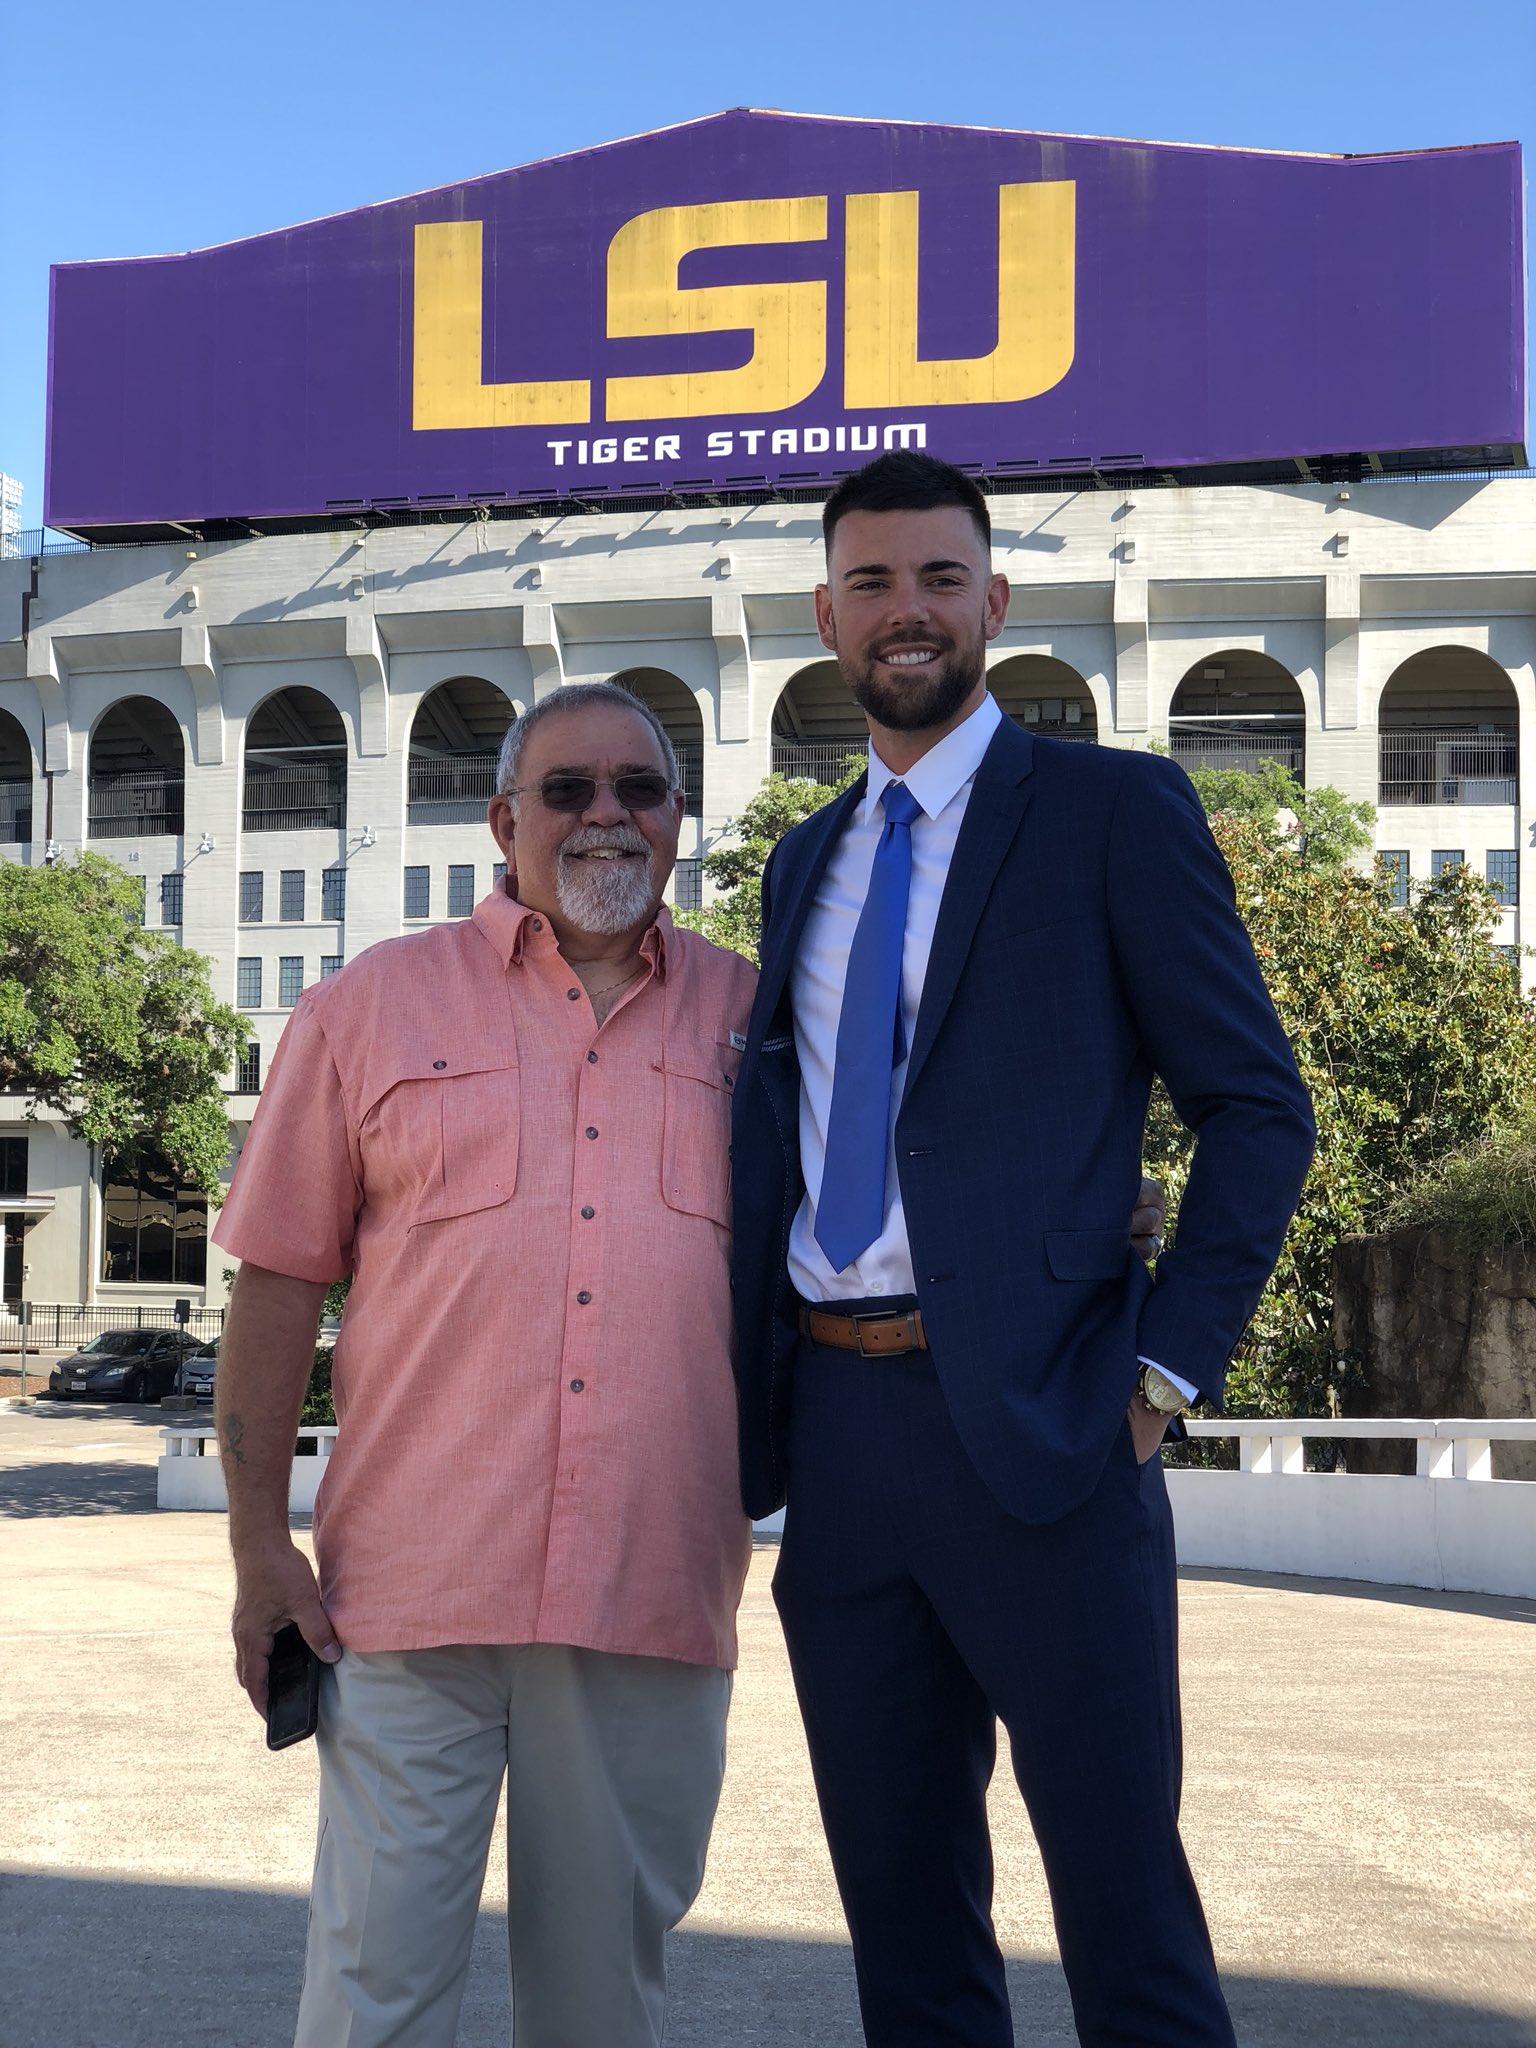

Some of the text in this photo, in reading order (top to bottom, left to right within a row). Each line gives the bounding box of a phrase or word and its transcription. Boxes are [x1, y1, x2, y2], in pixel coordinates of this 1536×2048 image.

[412, 180, 1076, 431] LSU
[546, 423, 927, 466] TIGER STADIUM
